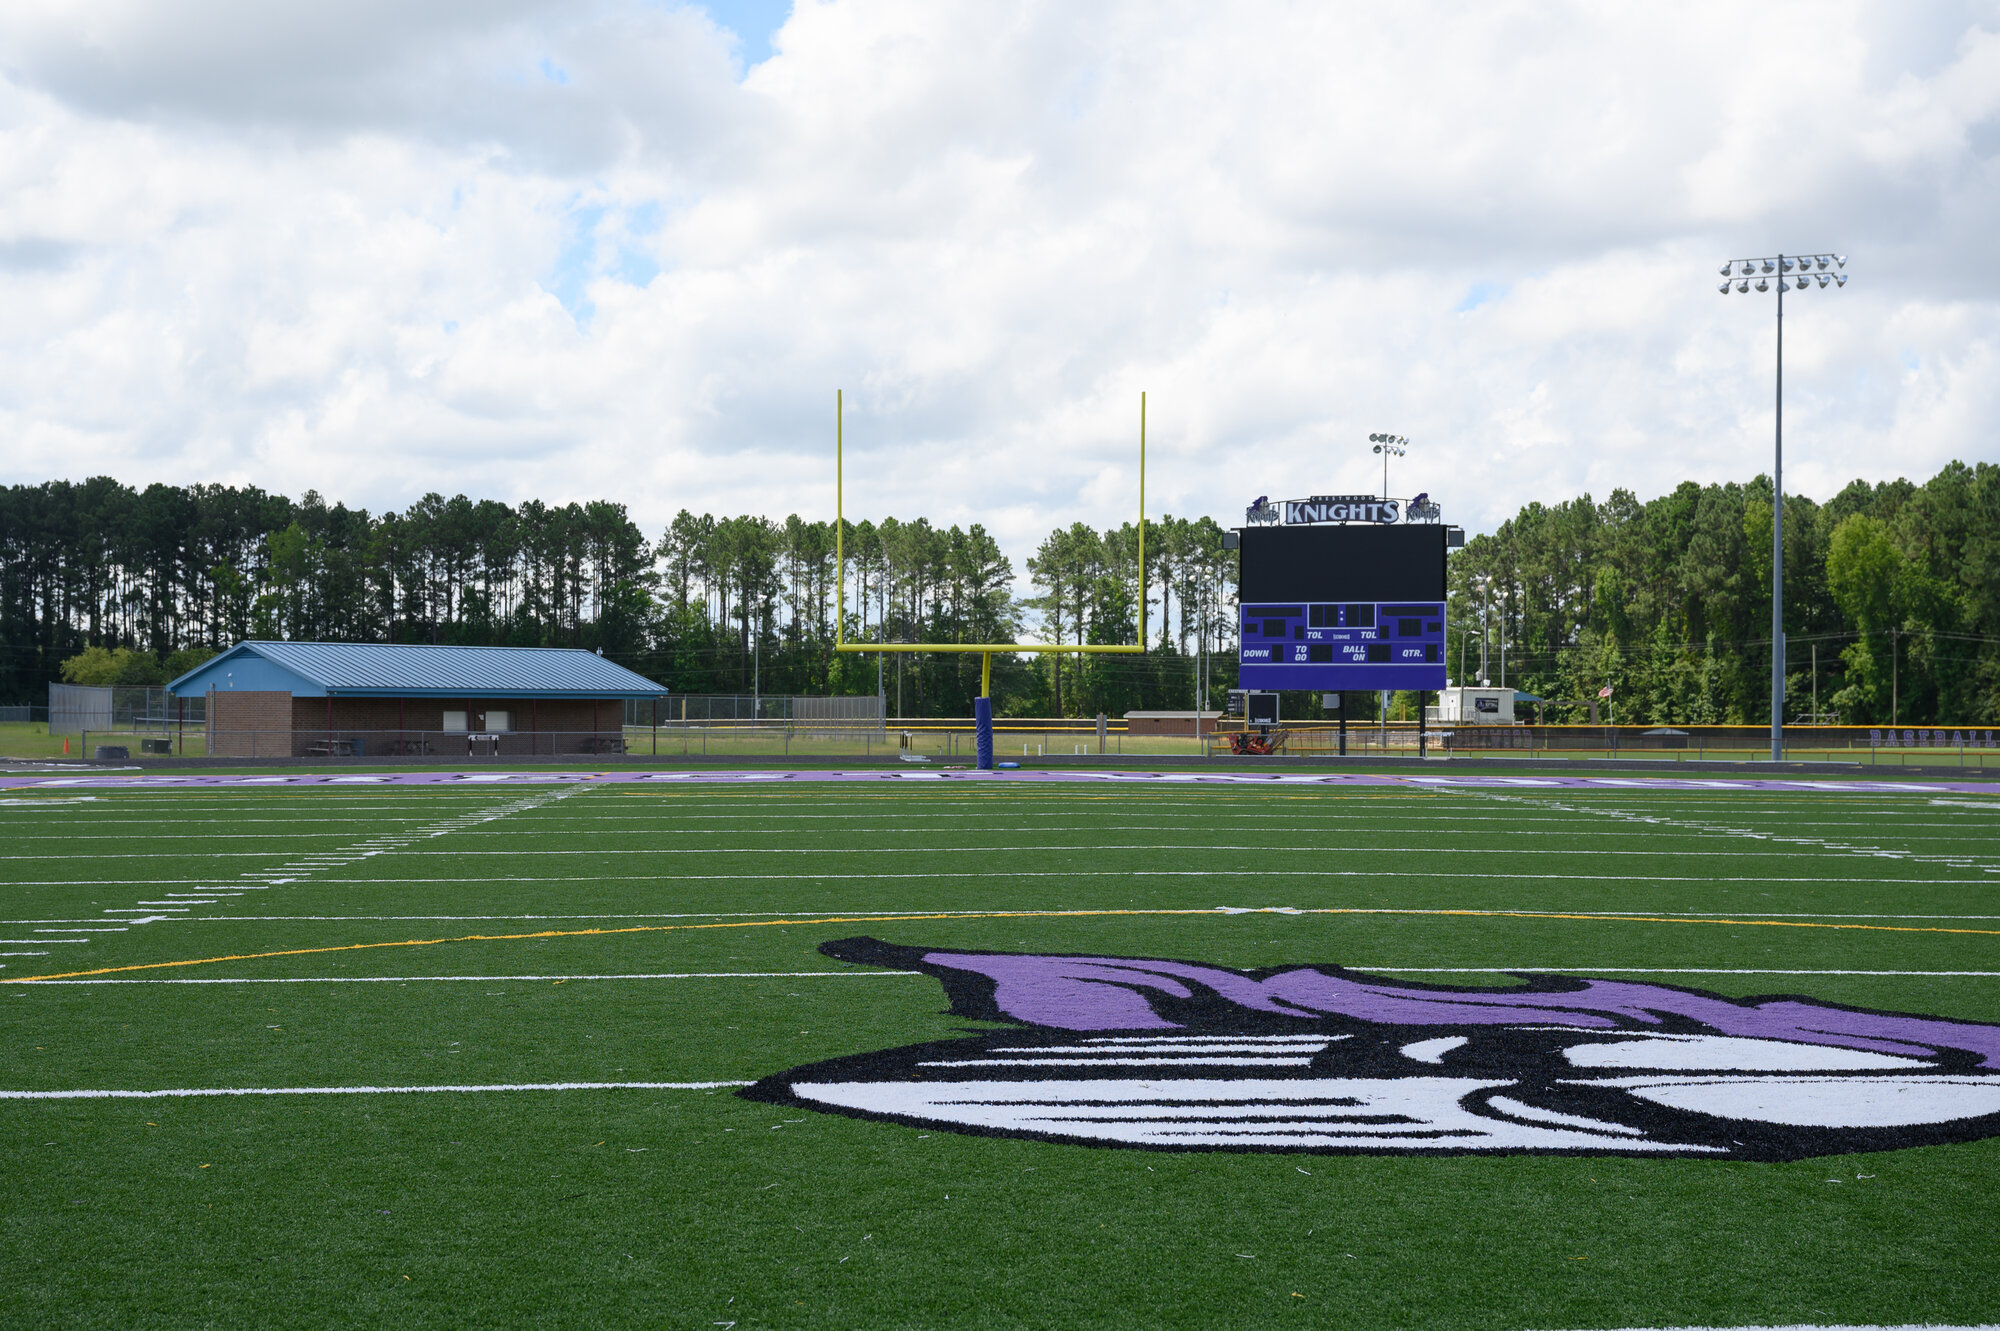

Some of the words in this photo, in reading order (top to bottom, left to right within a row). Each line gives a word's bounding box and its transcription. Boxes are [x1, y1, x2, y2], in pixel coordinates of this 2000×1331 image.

[1287, 502, 1398, 523] KNIGHTS
[1307, 631, 1323, 639] TOL
[1360, 631, 1377, 639] TOL
[1243, 649, 1269, 657] DOWN
[1295, 645, 1307, 653] TO
[1343, 645, 1365, 653] BALL
[1402, 649, 1423, 657] QTR.
[1294, 653, 1307, 661] GO
[1352, 653, 1365, 661] ON
[1870, 730, 1997, 747] BASEBALL
